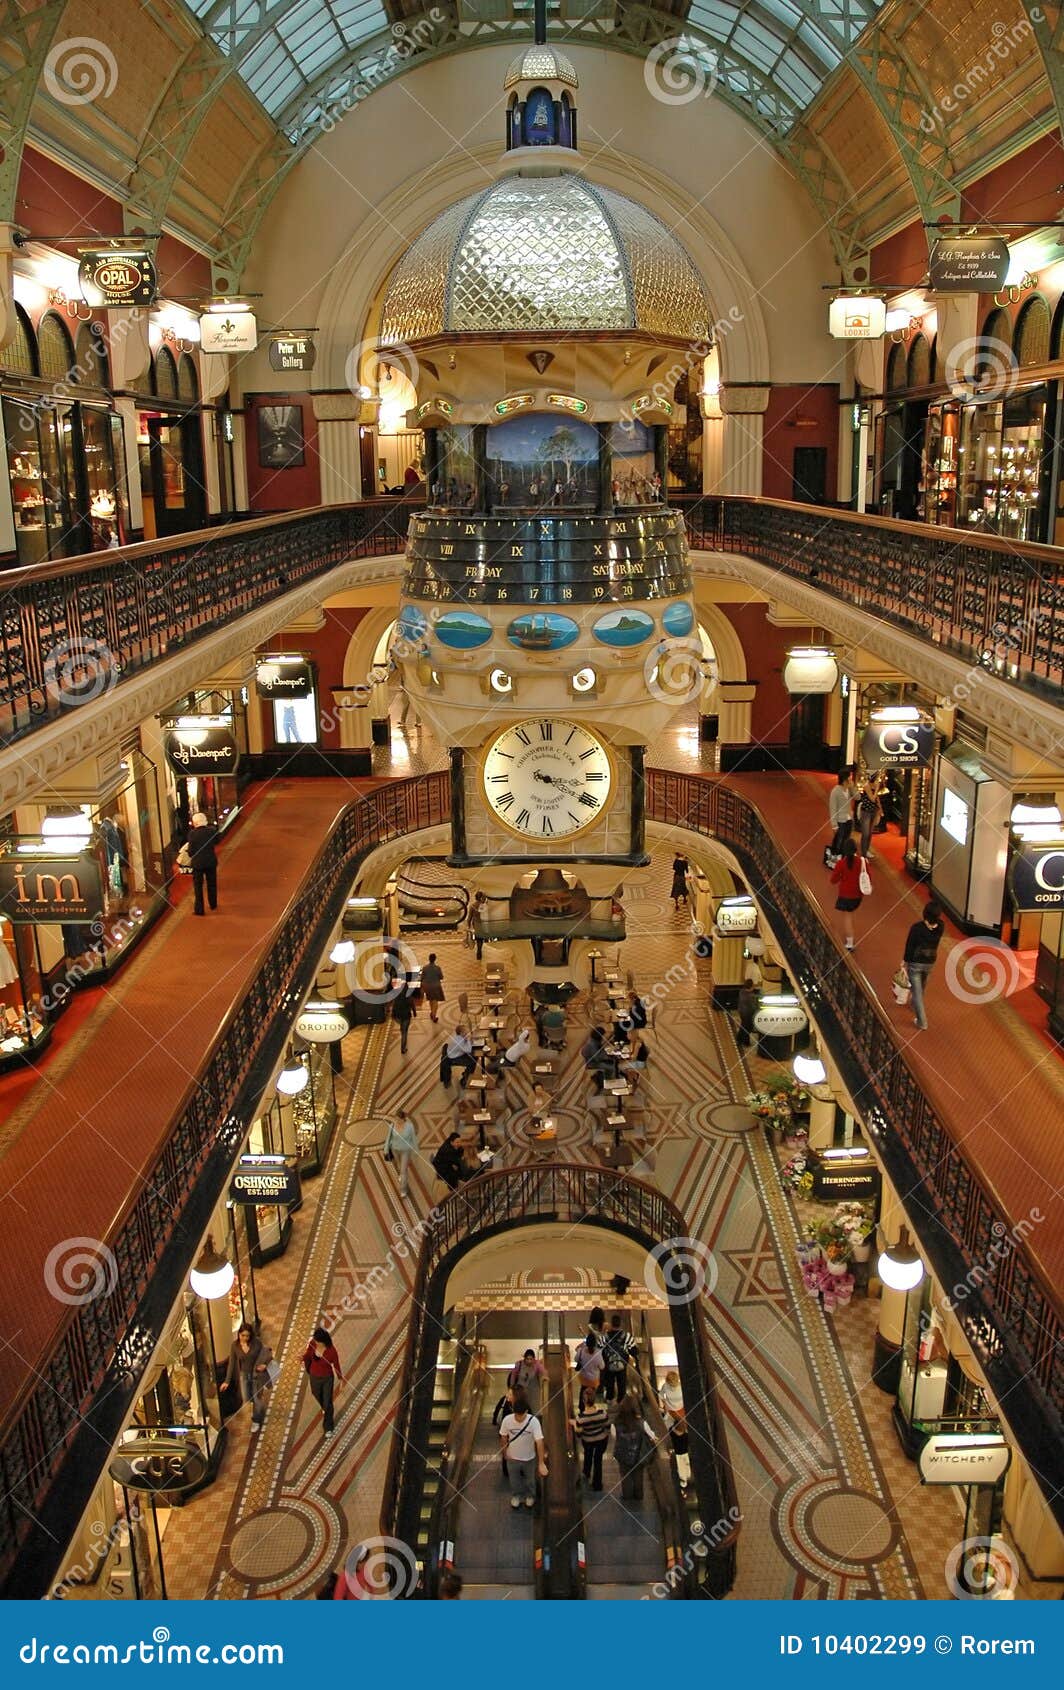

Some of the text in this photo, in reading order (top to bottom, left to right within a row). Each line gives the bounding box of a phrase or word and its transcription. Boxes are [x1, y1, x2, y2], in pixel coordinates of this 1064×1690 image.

[100, 270, 134, 285] OPAL
[278, 343, 306, 354] Peter Lik
[282, 357, 303, 369] Gallery
[465, 525, 475, 534] IX
[541, 525, 549, 534] X
[616, 523, 627, 533] XI
[440, 545, 453, 555] VIII
[511, 546, 523, 556] IX
[593, 545, 602, 555] X
[465, 566, 502, 577] FRDAY
[468, 588, 477, 598] 15
[497, 589, 507, 599] 16
[529, 588, 539, 599] 17
[563, 588, 572, 599] 18
[594, 587, 604, 597] 19
[623, 585, 633, 596] 20
[879, 726, 919, 755] GS
[190, 746, 232, 762] Davenport
[1035, 851, 1064, 892] G
[14, 864, 84, 903] im
[50, 906, 87, 914] bodywear
[721, 913, 754, 926] Bacio
[299, 1022, 345, 1031] OROTON
[234, 1175, 287, 1189] OSHKOSH
[928, 1455, 993, 1465] WITCHERY
